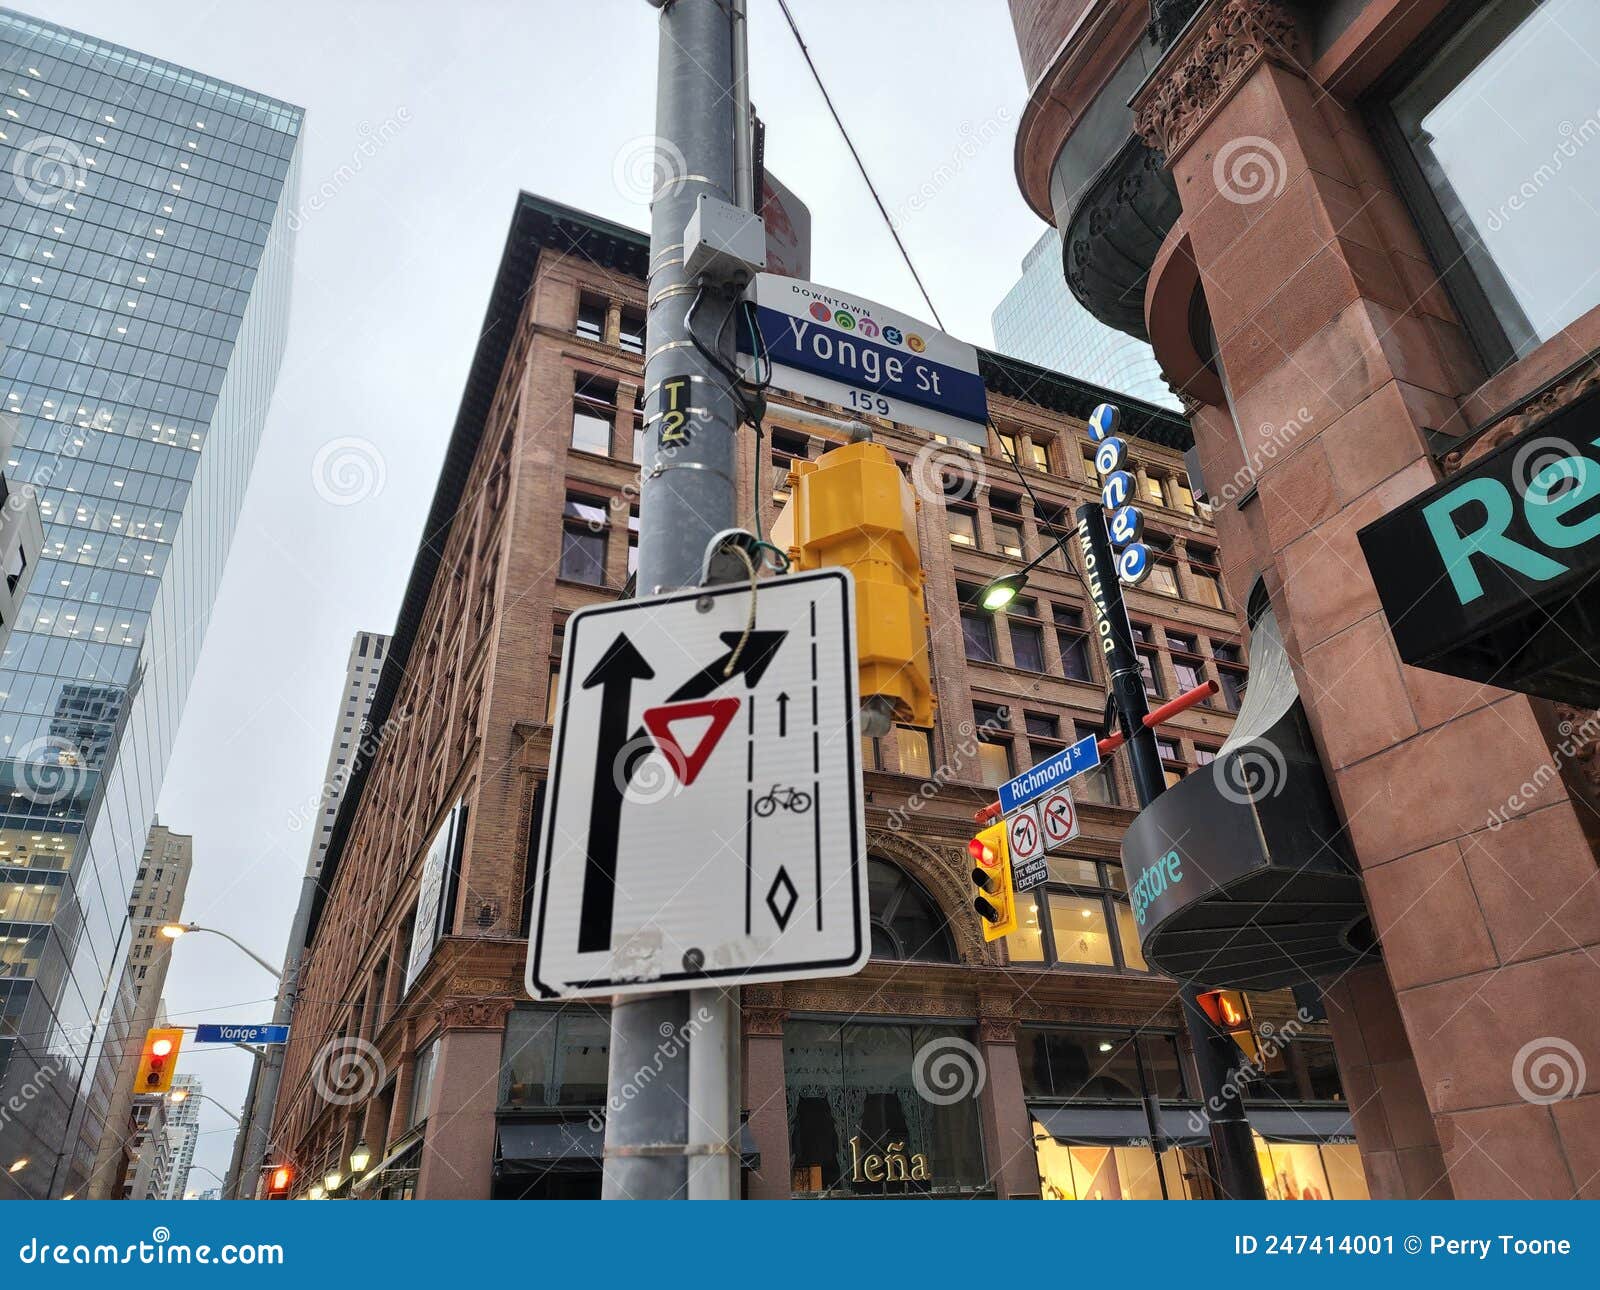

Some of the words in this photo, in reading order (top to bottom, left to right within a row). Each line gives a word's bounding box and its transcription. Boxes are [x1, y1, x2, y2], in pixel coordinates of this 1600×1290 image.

[791, 285, 871, 318] DOWNTOWN
[788, 316, 904, 384] Yonge
[915, 365, 942, 396] St
[848, 390, 889, 416] 159
[1422, 437, 1600, 606] Re
[1077, 517, 1116, 654] DOWNTOWN
[1011, 754, 1073, 801] Richmond
[1073, 747, 1082, 758] St
[1018, 869, 1047, 889] EXCEPTED
[1025, 858, 1046, 874] VEHICLES
[220, 1026, 258, 1042] Yonge
[849, 1135, 933, 1183] leña
